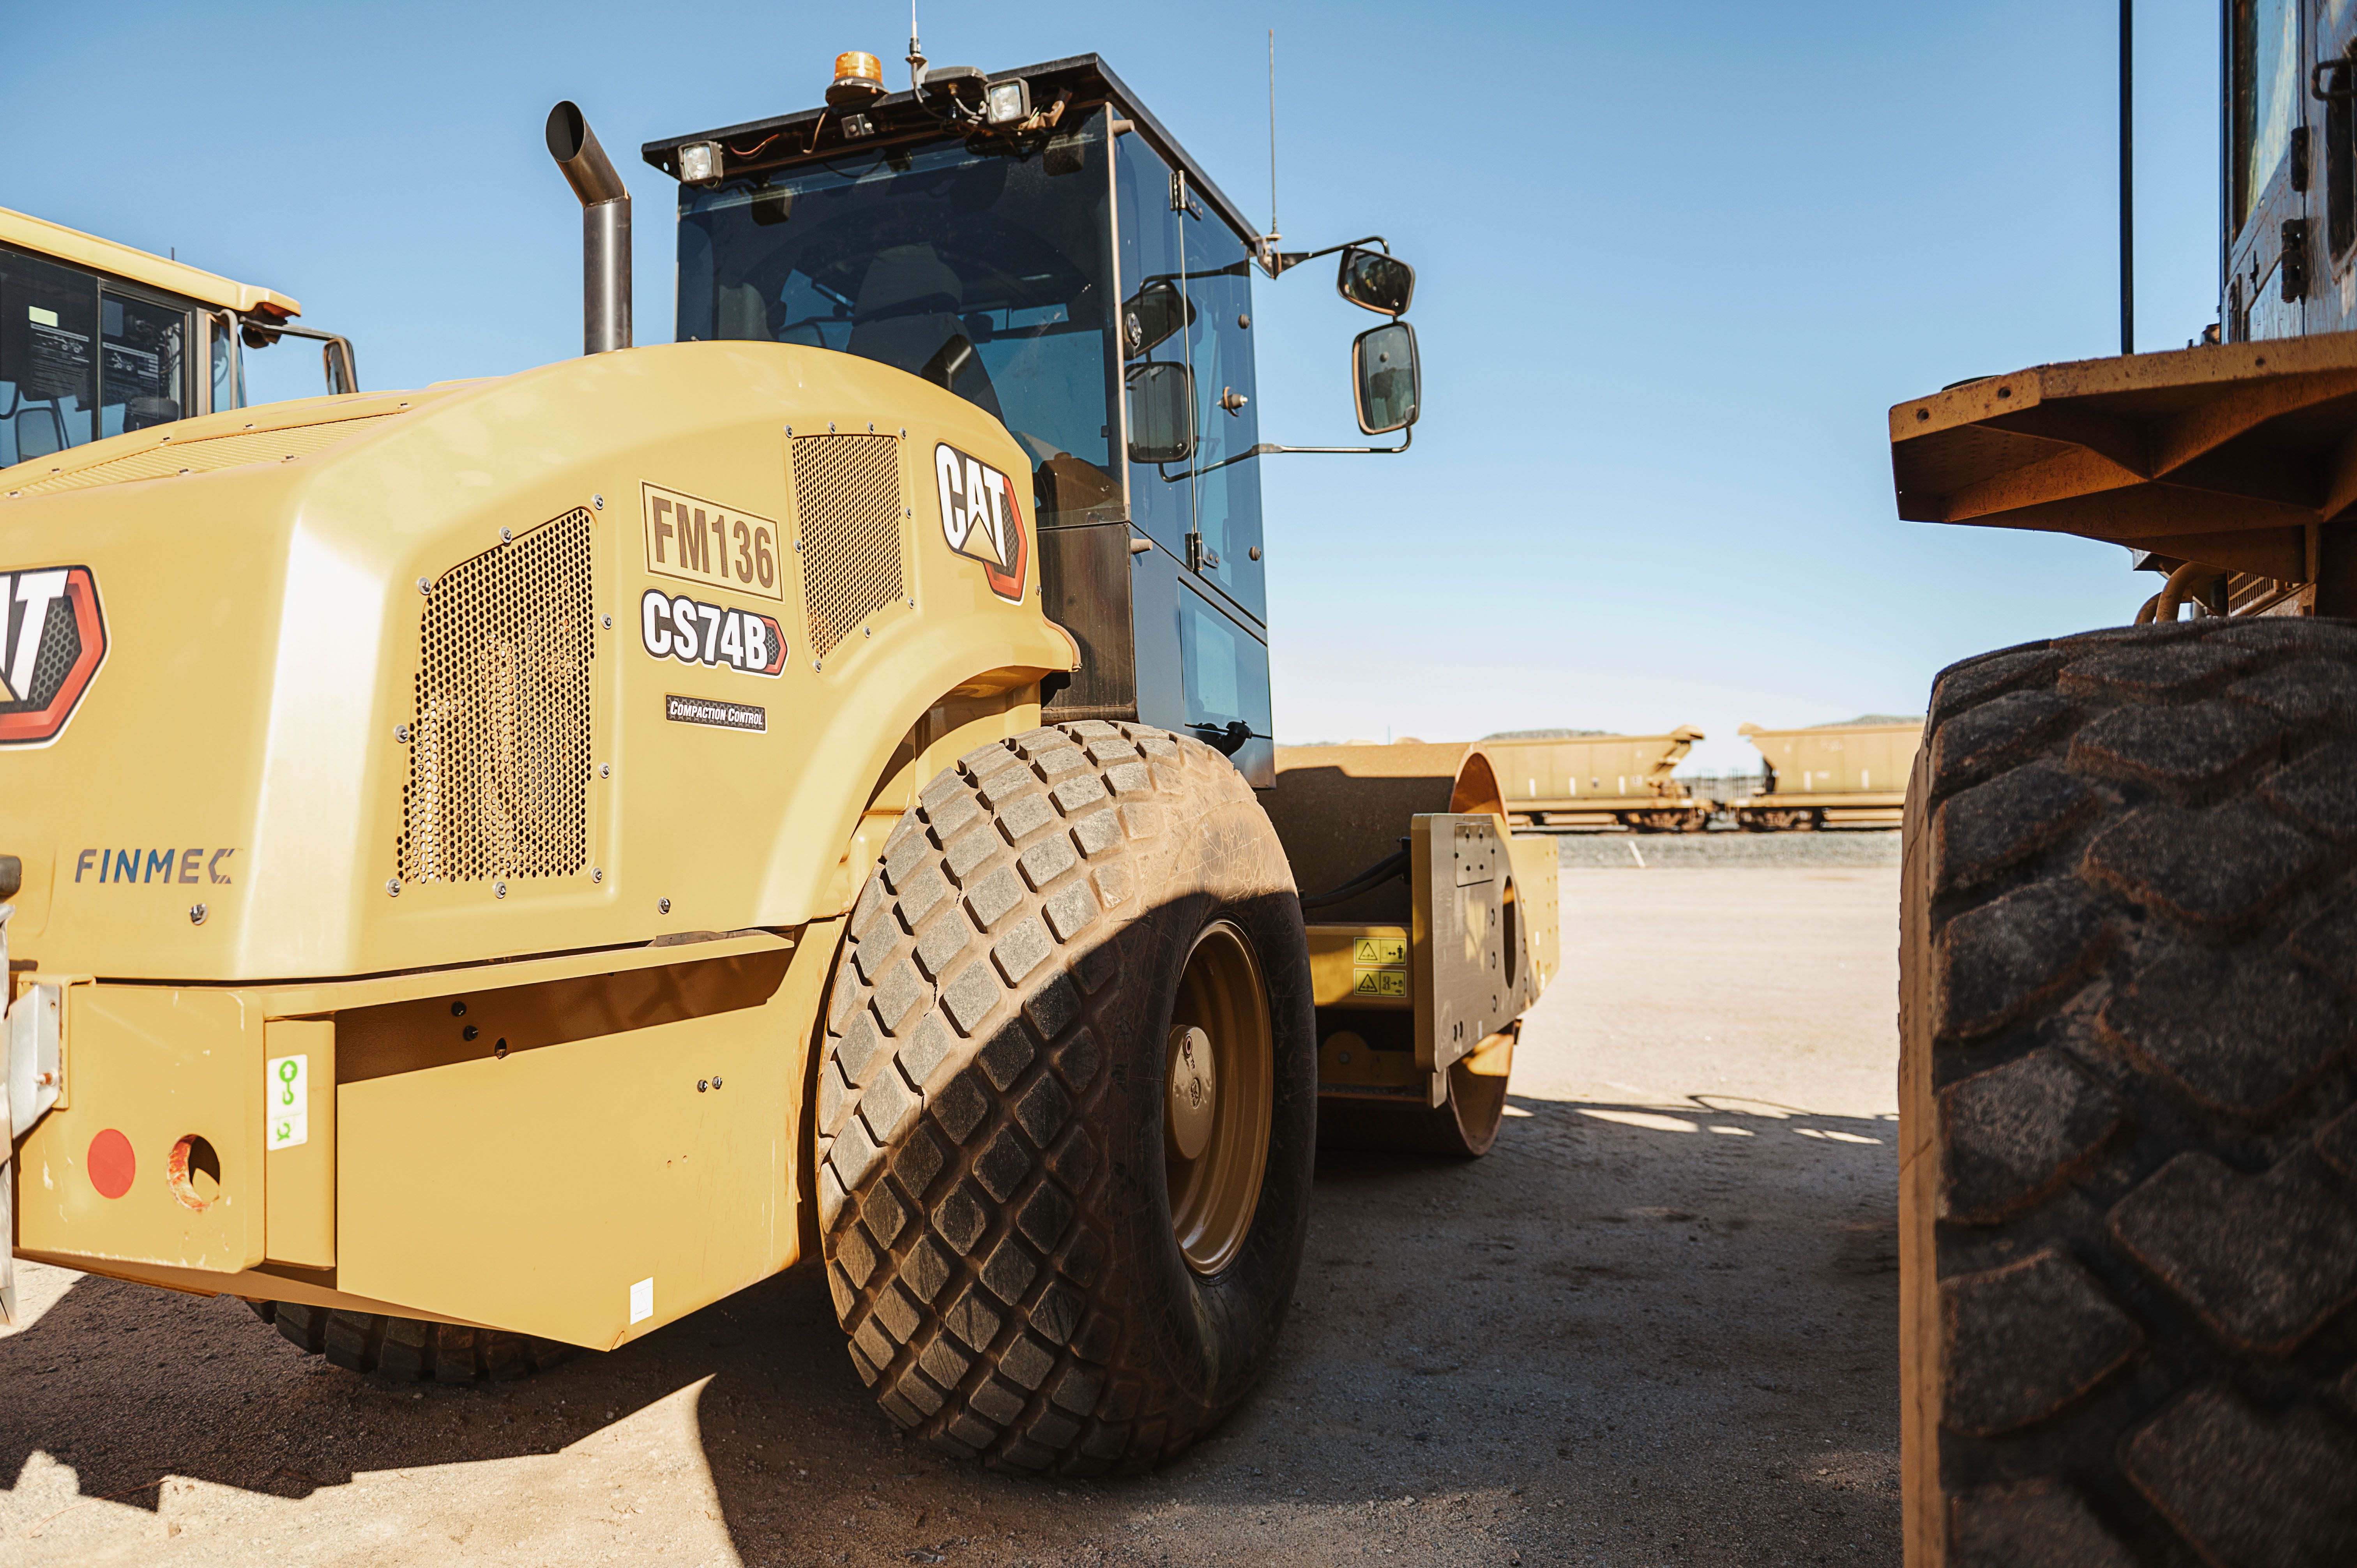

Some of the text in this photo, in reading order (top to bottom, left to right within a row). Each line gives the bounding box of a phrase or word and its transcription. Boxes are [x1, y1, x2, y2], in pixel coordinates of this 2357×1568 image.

[652, 496, 774, 589] FM136
[936, 445, 1007, 567] CAT
[643, 592, 768, 671] CS74B
[75, 848, 235, 885] FINMEC
